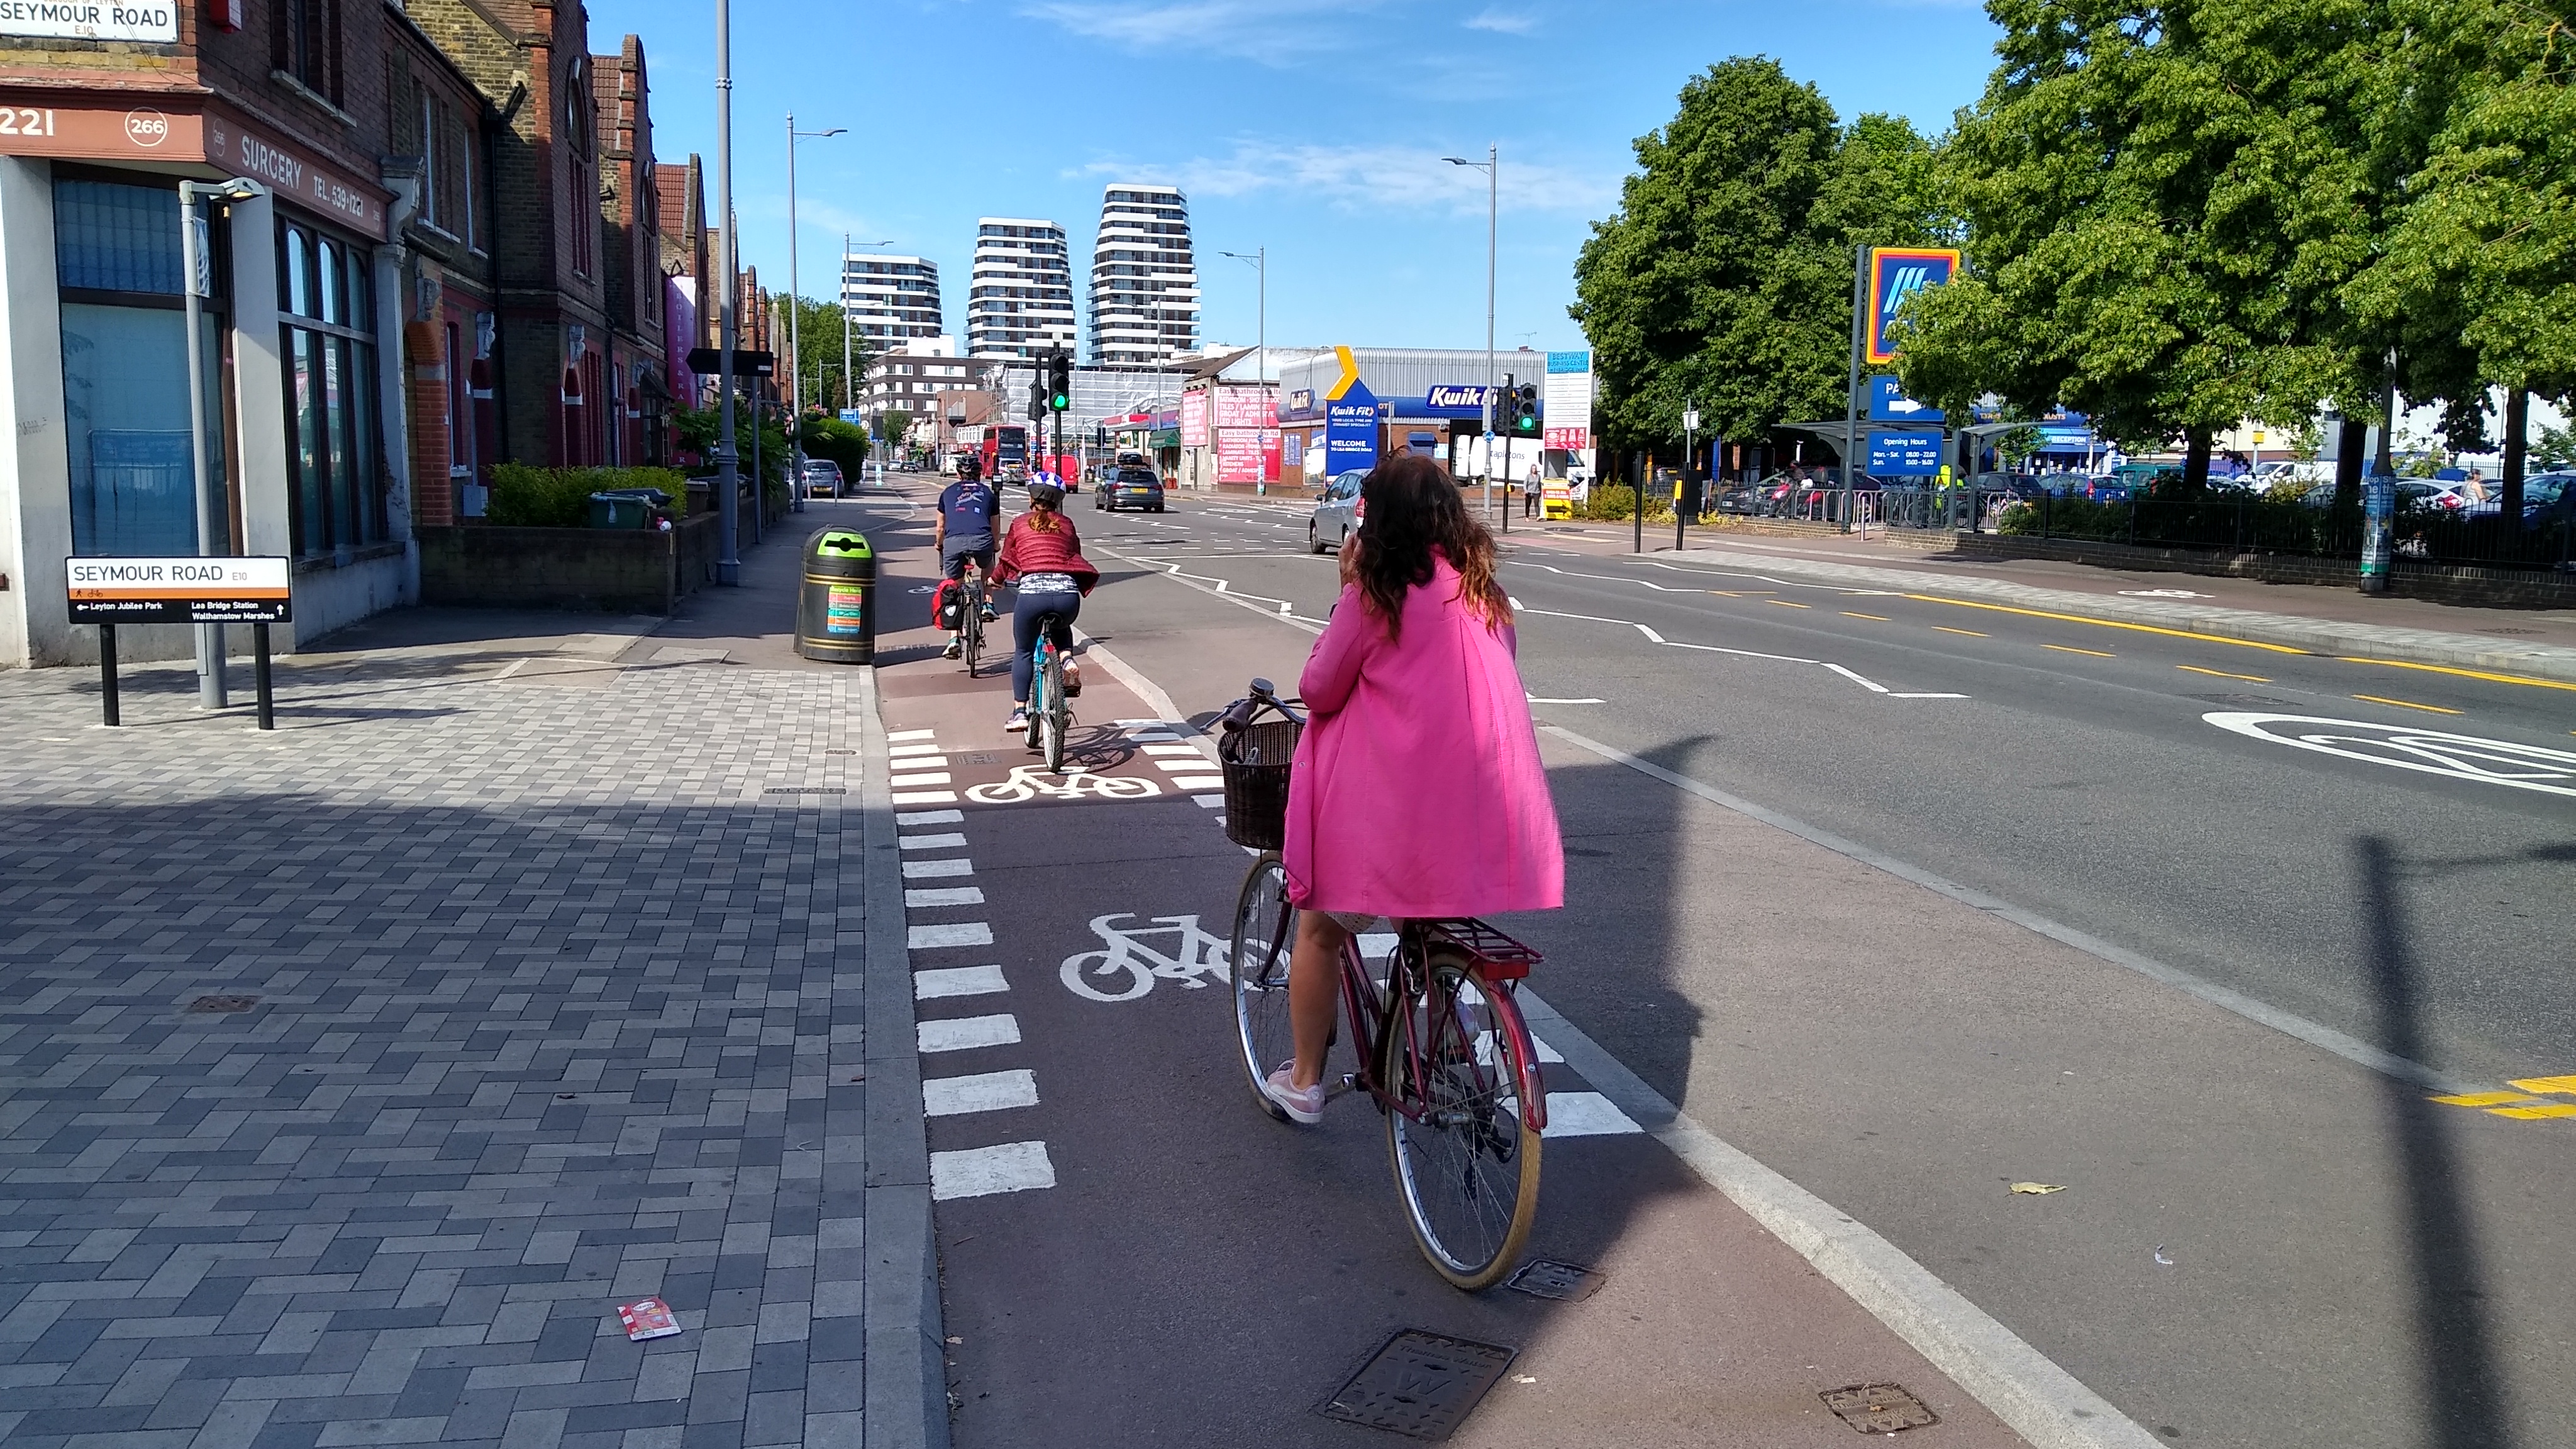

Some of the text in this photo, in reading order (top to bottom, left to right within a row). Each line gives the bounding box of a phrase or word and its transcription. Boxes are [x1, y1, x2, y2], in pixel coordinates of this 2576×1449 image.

[0, 2, 168, 26] SEYMOUR ROAD
[131, 119, 165, 134] 266
[242, 135, 302, 189] SURGERY
[314, 175, 330, 201] TEL.
[1291, 392, 1302, 411] Kwik
[1430, 387, 1481, 407] Kwik
[1330, 406, 1355, 416] Kwik
[1356, 406, 1370, 416] Fit
[1884, 438, 1908, 447] Opening
[74, 566, 247, 581] SEYMOUR ROAD E10
[90, 602, 163, 611] Leyton Jubilee Park
[207, 602, 231, 611] Bridge
[192, 612, 242, 620] Walthamstow
